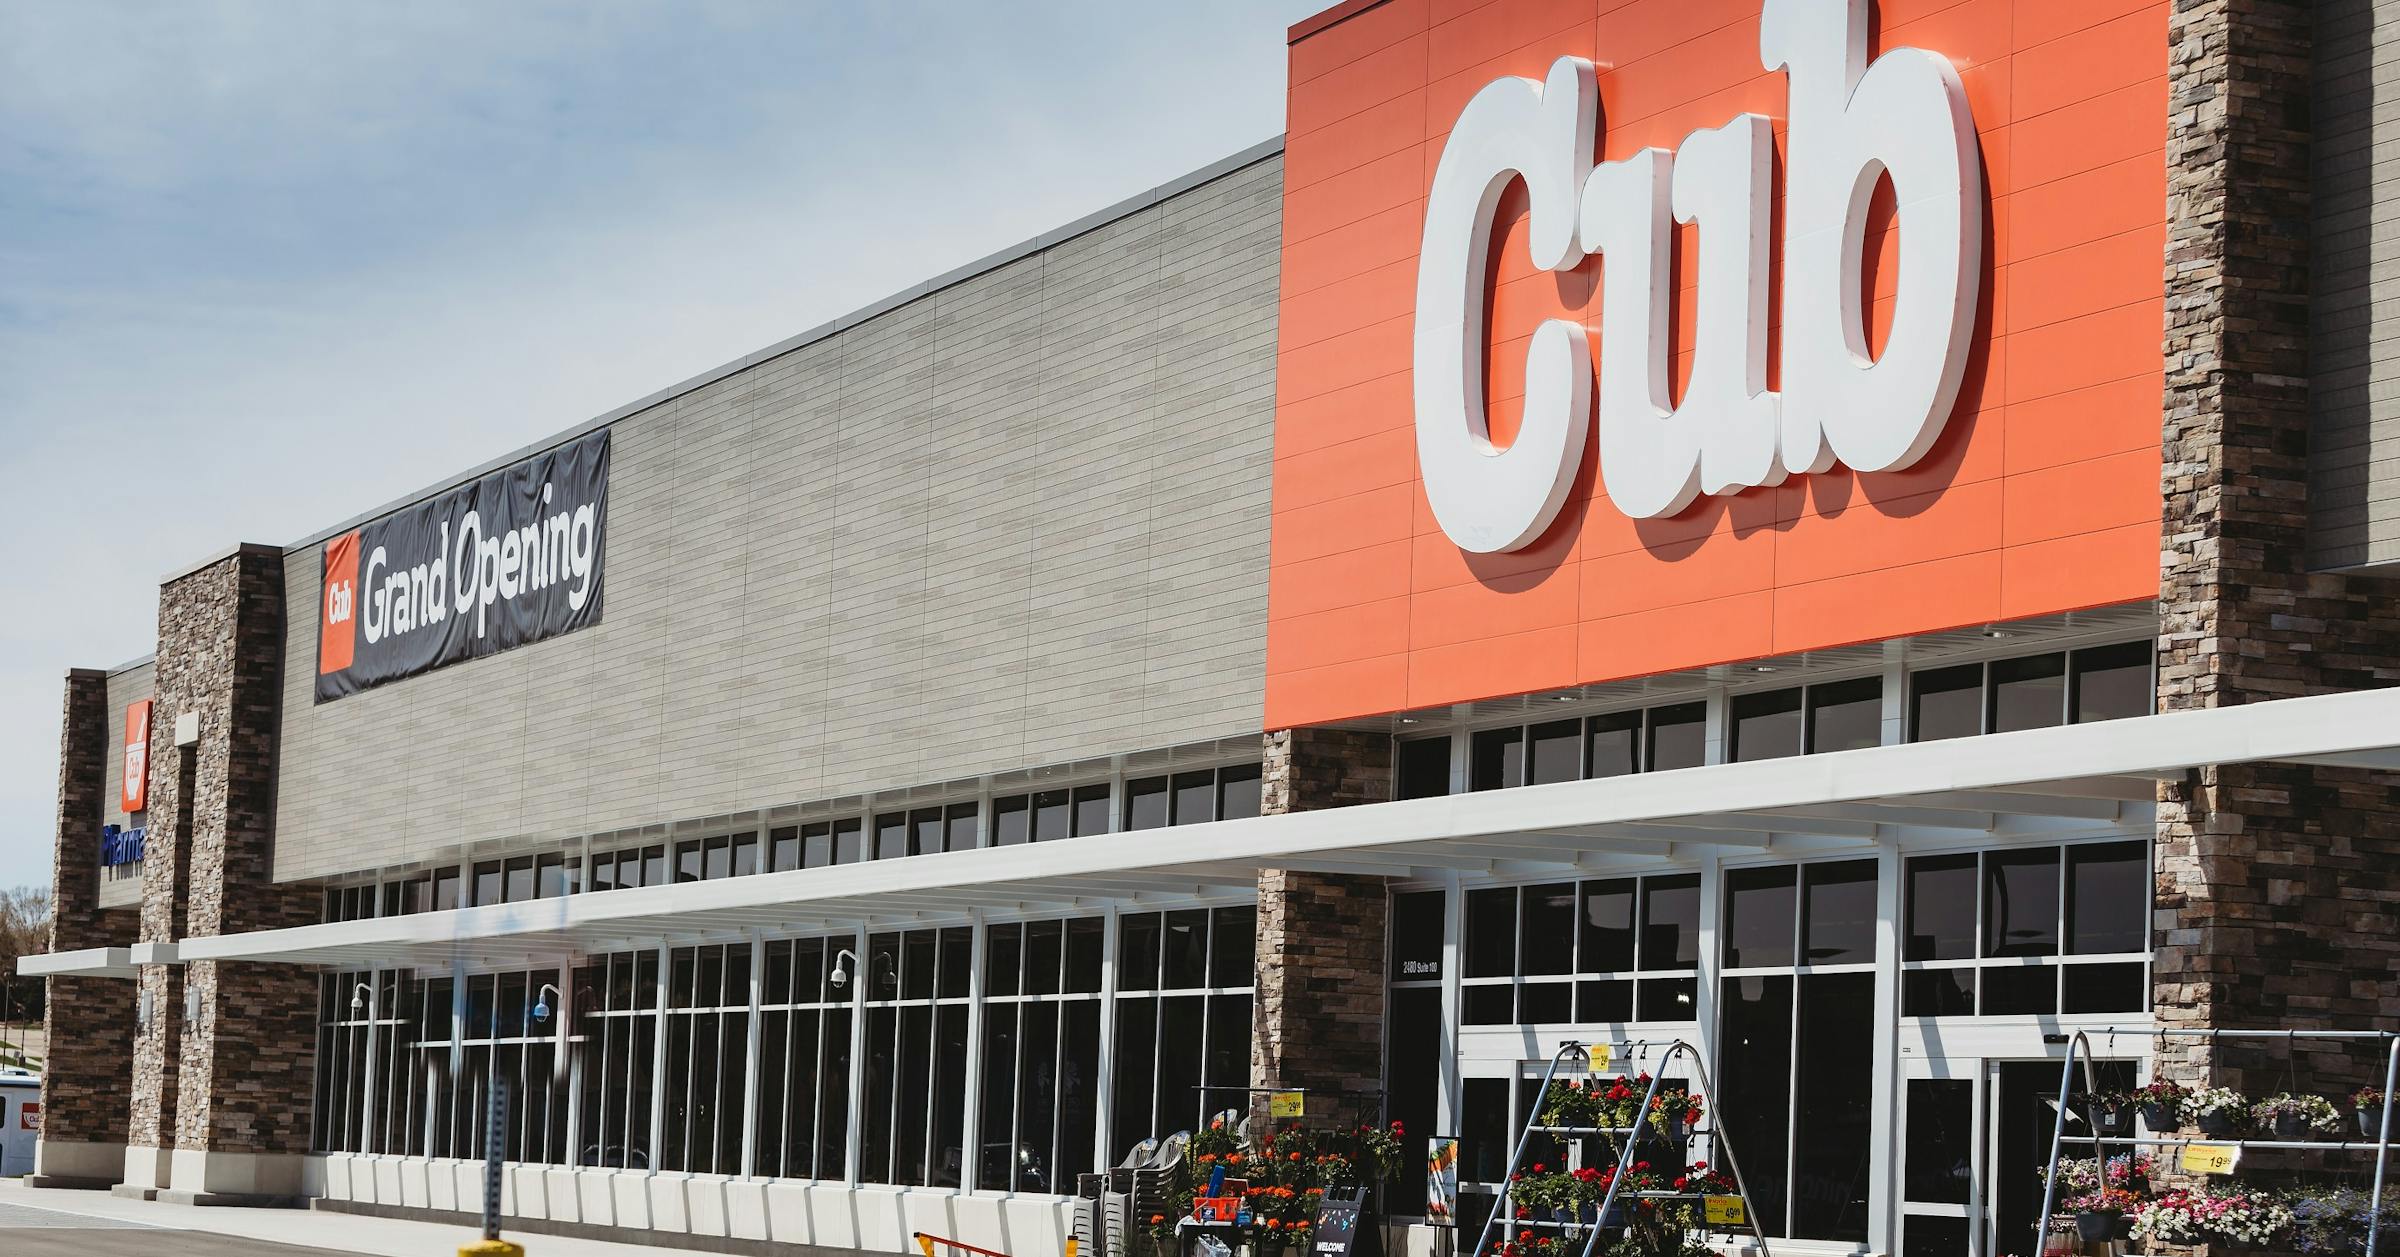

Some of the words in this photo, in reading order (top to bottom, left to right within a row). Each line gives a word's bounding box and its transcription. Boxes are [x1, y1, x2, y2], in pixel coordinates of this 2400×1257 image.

[1413, 0, 1982, 553] Cub
[328, 579, 352, 625] Cub
[363, 520, 449, 644] Grand
[454, 482, 595, 639] Opening
[1316, 1241, 1346, 1252] WELCOME
